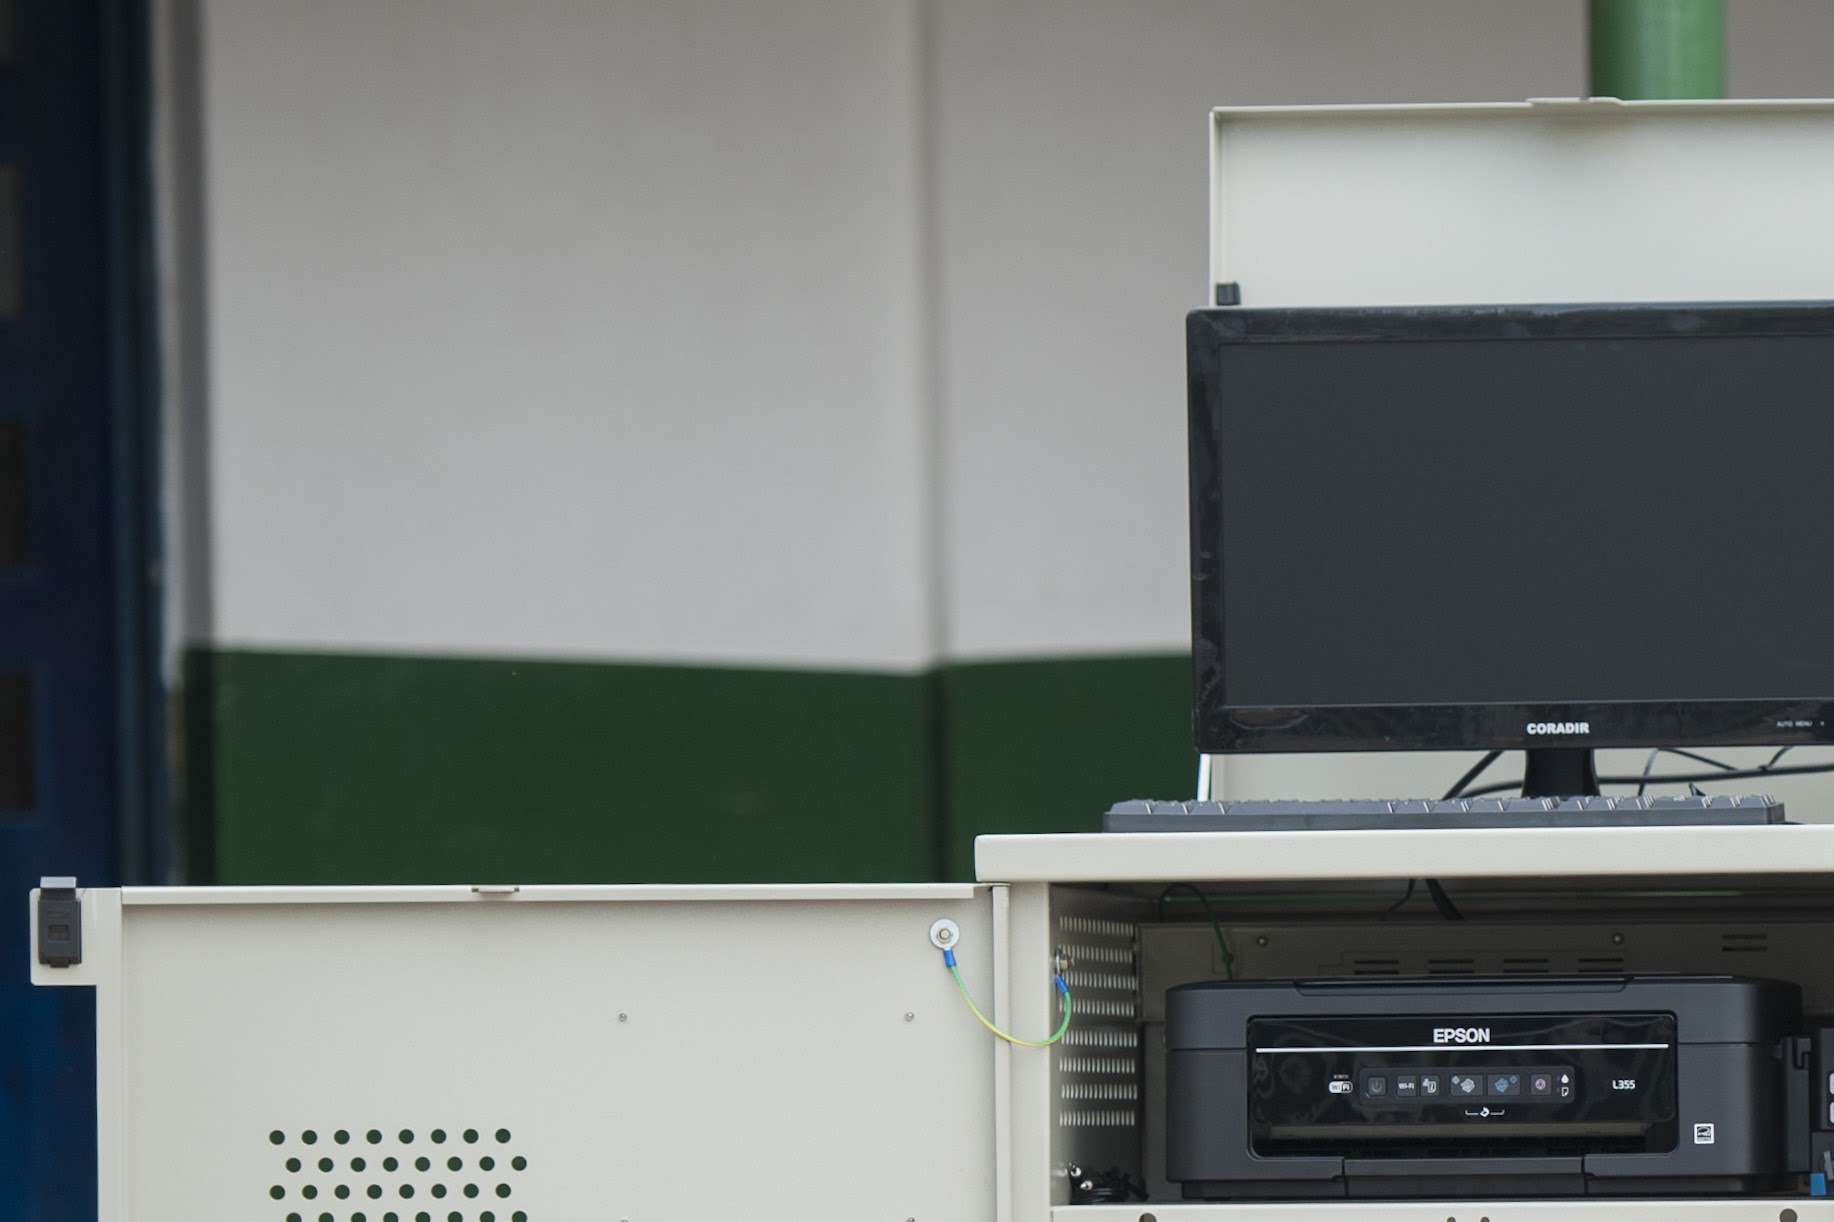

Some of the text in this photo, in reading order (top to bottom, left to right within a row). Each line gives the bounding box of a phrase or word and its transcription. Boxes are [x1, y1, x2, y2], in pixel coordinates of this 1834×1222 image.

[1526, 722, 1590, 735] CORADIR
[1433, 1027, 1490, 1043] EPSON
[1612, 1079, 1636, 1090] L355
